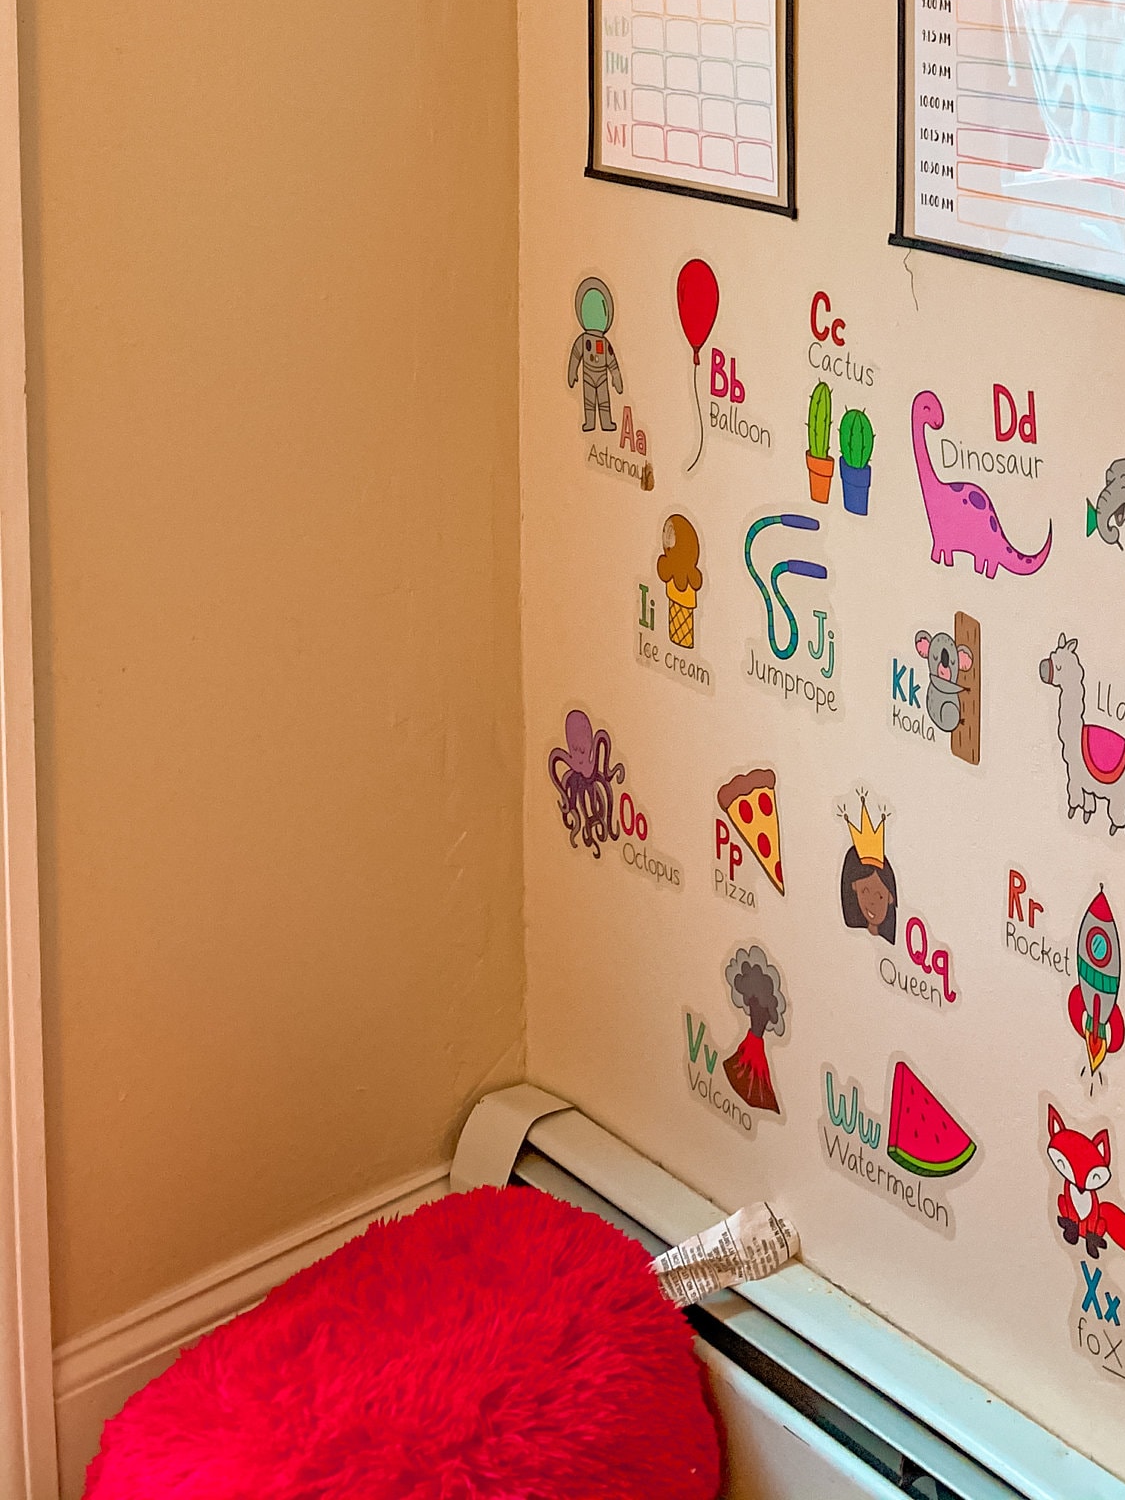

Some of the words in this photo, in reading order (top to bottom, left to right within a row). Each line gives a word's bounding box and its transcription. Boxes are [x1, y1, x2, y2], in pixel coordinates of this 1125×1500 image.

[810, 291, 846, 347] Cc
[710, 347, 746, 403] Bb
[807, 341, 875, 388] Cactus
[620, 406, 647, 456] Aa
[709, 401, 771, 448] Balloon
[993, 383, 1037, 444] Dd
[940, 438, 1044, 479] Dinosaur
[638, 583, 655, 631] Ii
[638, 632, 660, 664] Ice
[664, 652, 711, 687] cream
[807, 610, 835, 679] Jj
[746, 649, 838, 714] Jumprope
[892, 657, 921, 709] Kk
[892, 704, 936, 743] Koala
[619, 792, 648, 841] Oo
[622, 842, 681, 886] Octopus
[715, 818, 743, 881] Pp
[714, 868, 756, 909] Pizza
[1008, 869, 1044, 928] Rr
[905, 916, 956, 1003] Qq
[1005, 921, 1071, 977] Rocket
[879, 957, 942, 1008] Queen
[686, 1012, 718, 1075] Vv
[687, 1062, 753, 1132] Volcano
[826, 1071, 881, 1150] Ww
[823, 1125, 949, 1228] Watermelon
[1080, 1260, 1121, 1326] Xx
